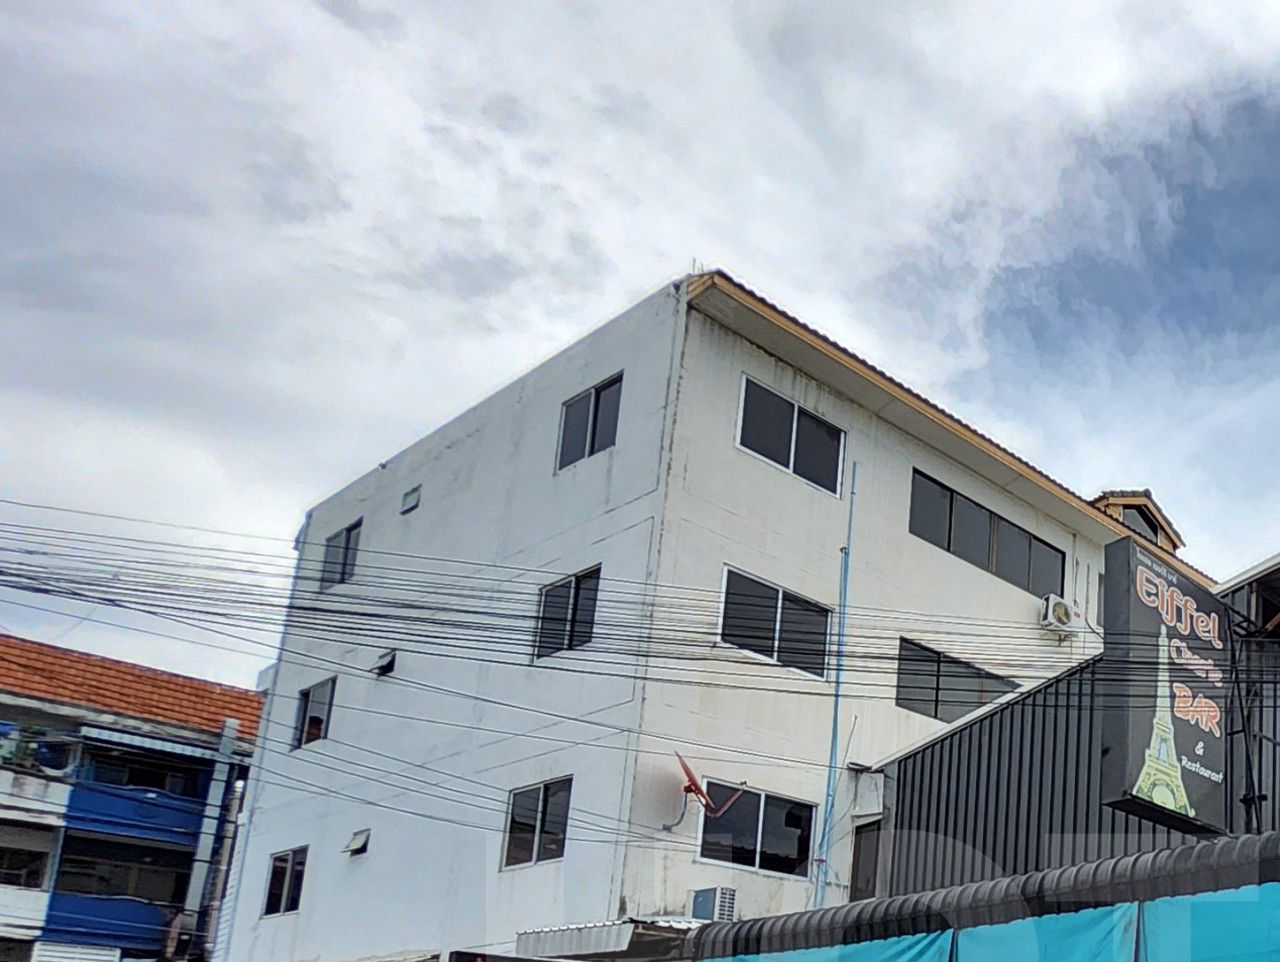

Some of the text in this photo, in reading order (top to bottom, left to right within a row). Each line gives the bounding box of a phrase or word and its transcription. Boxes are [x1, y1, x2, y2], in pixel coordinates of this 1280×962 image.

[1135, 565, 1223, 649] Eiffel
[1172, 682, 1222, 738] BAR
[1180, 755, 1224, 785] Restaurant
[1194, 740, 1206, 757] &
